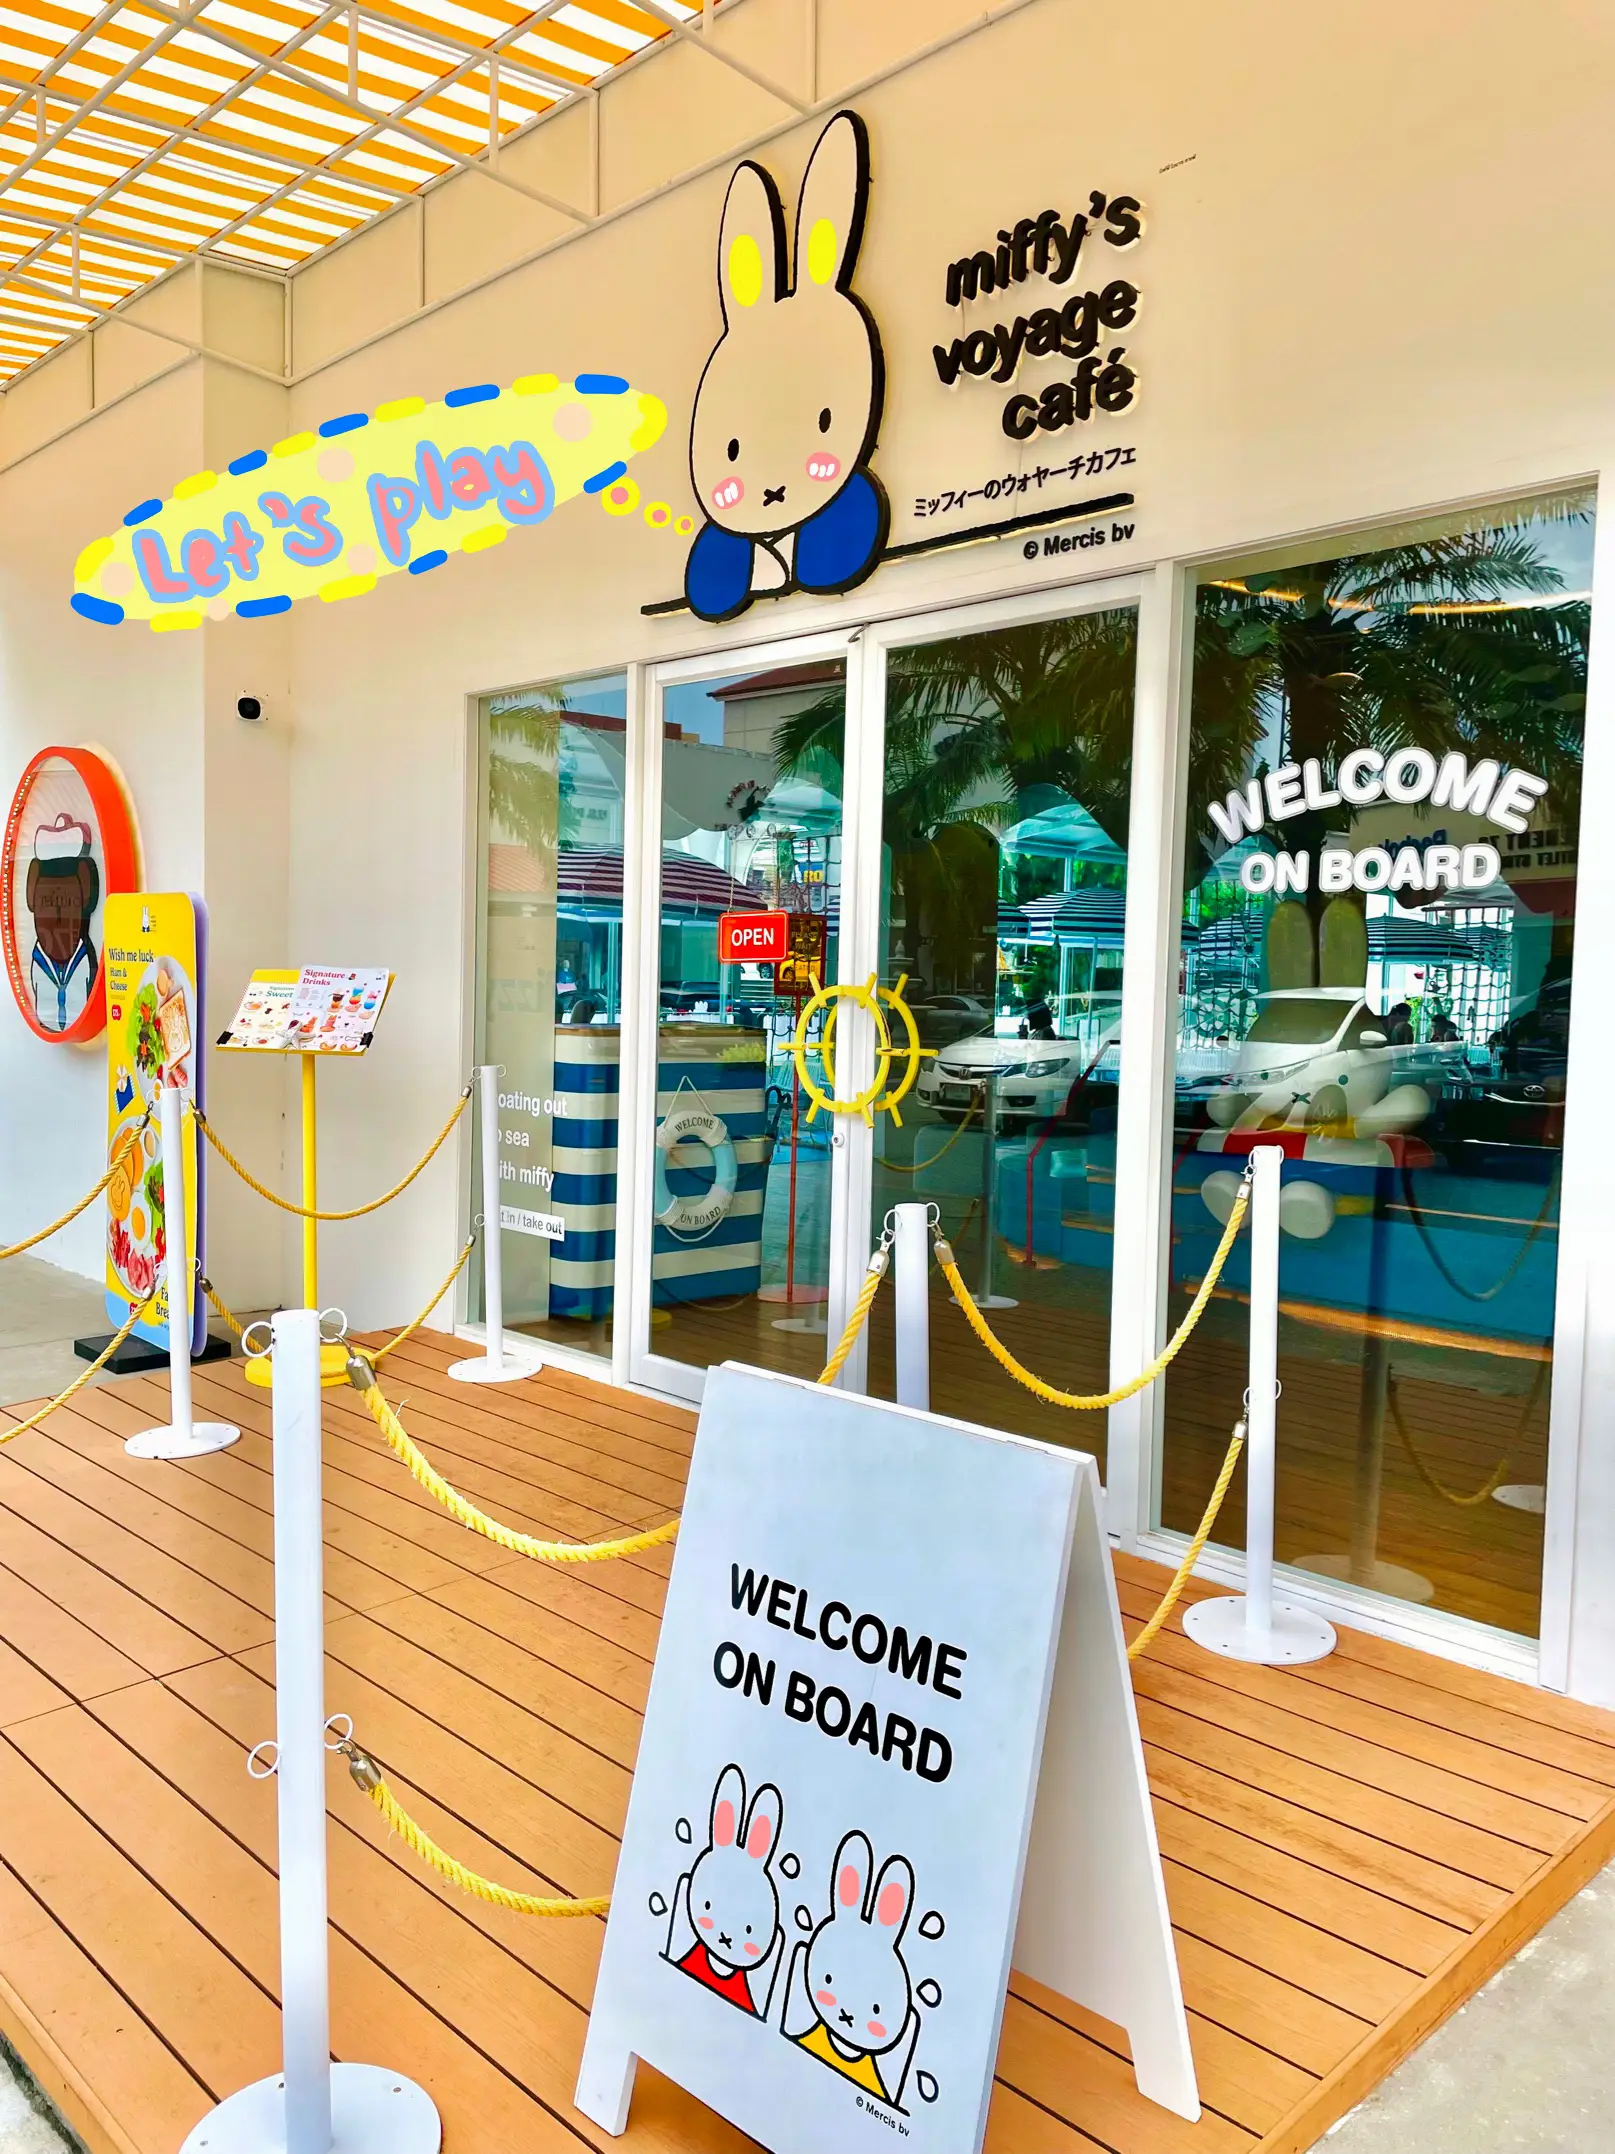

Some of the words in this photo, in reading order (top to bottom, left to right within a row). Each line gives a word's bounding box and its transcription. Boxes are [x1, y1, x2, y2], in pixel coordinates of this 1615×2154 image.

[946, 190, 1142, 307] miffy's
[932, 279, 1141, 387] voyage
[1002, 347, 1136, 441] café
[1044, 527, 1106, 556] Mercis
[1112, 523, 1135, 542] bv
[1207, 746, 1549, 844] WELCOME
[1240, 850, 1310, 893] ON
[1319, 843, 1502, 892] BOARD
[731, 928, 774, 947] OPEN
[109, 948, 125, 962] Wish
[127, 951, 138, 962] me
[139, 949, 154, 963] luck
[110, 980, 127, 991] Cheese
[302, 977, 331, 986] Drinks
[304, 969, 346, 979] Signature
[266, 990, 294, 998] Sweet
[498, 1090, 541, 1117] oating
[543, 1097, 568, 1117] out
[674, 1116, 714, 1133] WELCOME
[505, 1129, 530, 1148] sea
[499, 1160, 516, 1182] ith
[519, 1165, 554, 1193] miffy
[523, 1213, 544, 1231] take
[545, 1222, 563, 1236] out
[680, 1212, 693, 1225] ON
[694, 1206, 721, 1226] BOARD
[731, 1562, 968, 1700] WELCOME
[713, 1641, 776, 1706] ON
[784, 1670, 952, 1783] BOARD
[865, 2101, 896, 2129] Mercis
[898, 2122, 910, 2137] bv
